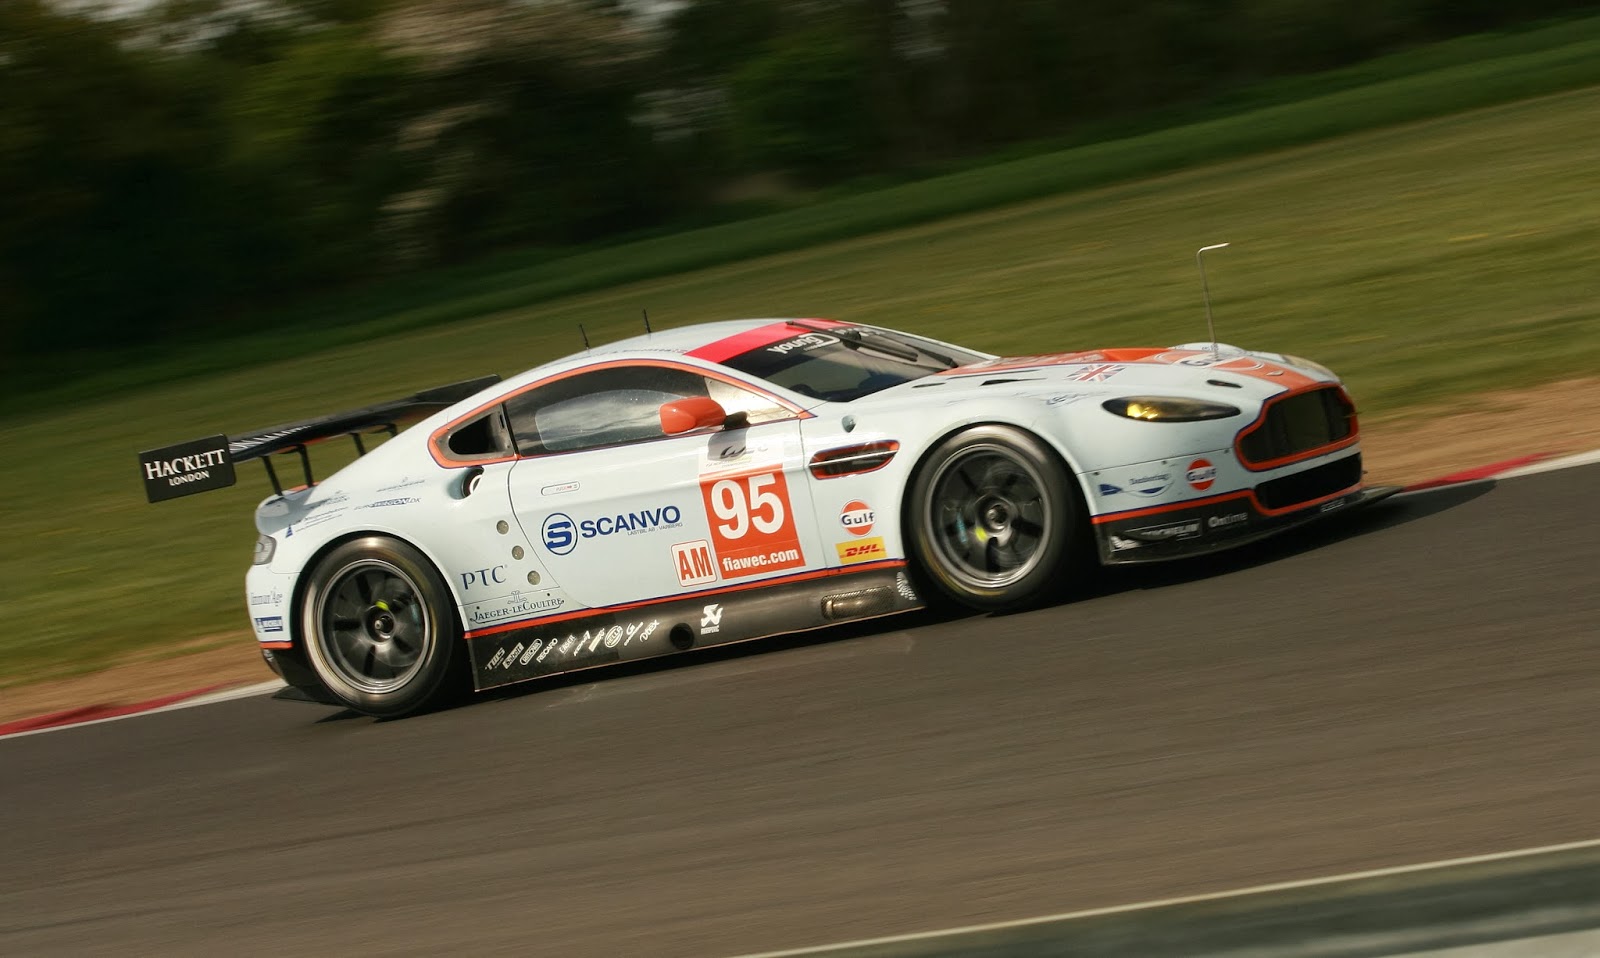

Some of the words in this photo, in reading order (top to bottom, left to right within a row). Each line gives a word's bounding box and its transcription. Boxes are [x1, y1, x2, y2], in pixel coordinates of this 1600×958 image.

[144, 448, 225, 480] HACKETT
[168, 470, 210, 486] LONDON
[711, 472, 784, 540] 95
[841, 511, 874, 526] Gulf
[580, 505, 681, 538] SCANVO
[722, 548, 800, 572] fiawec.com
[845, 543, 880, 557] DHL
[678, 546, 713, 581] AM
[460, 565, 507, 590] PTC
[606, 626, 623, 647] HELLA
[536, 638, 558, 663] RECARO
